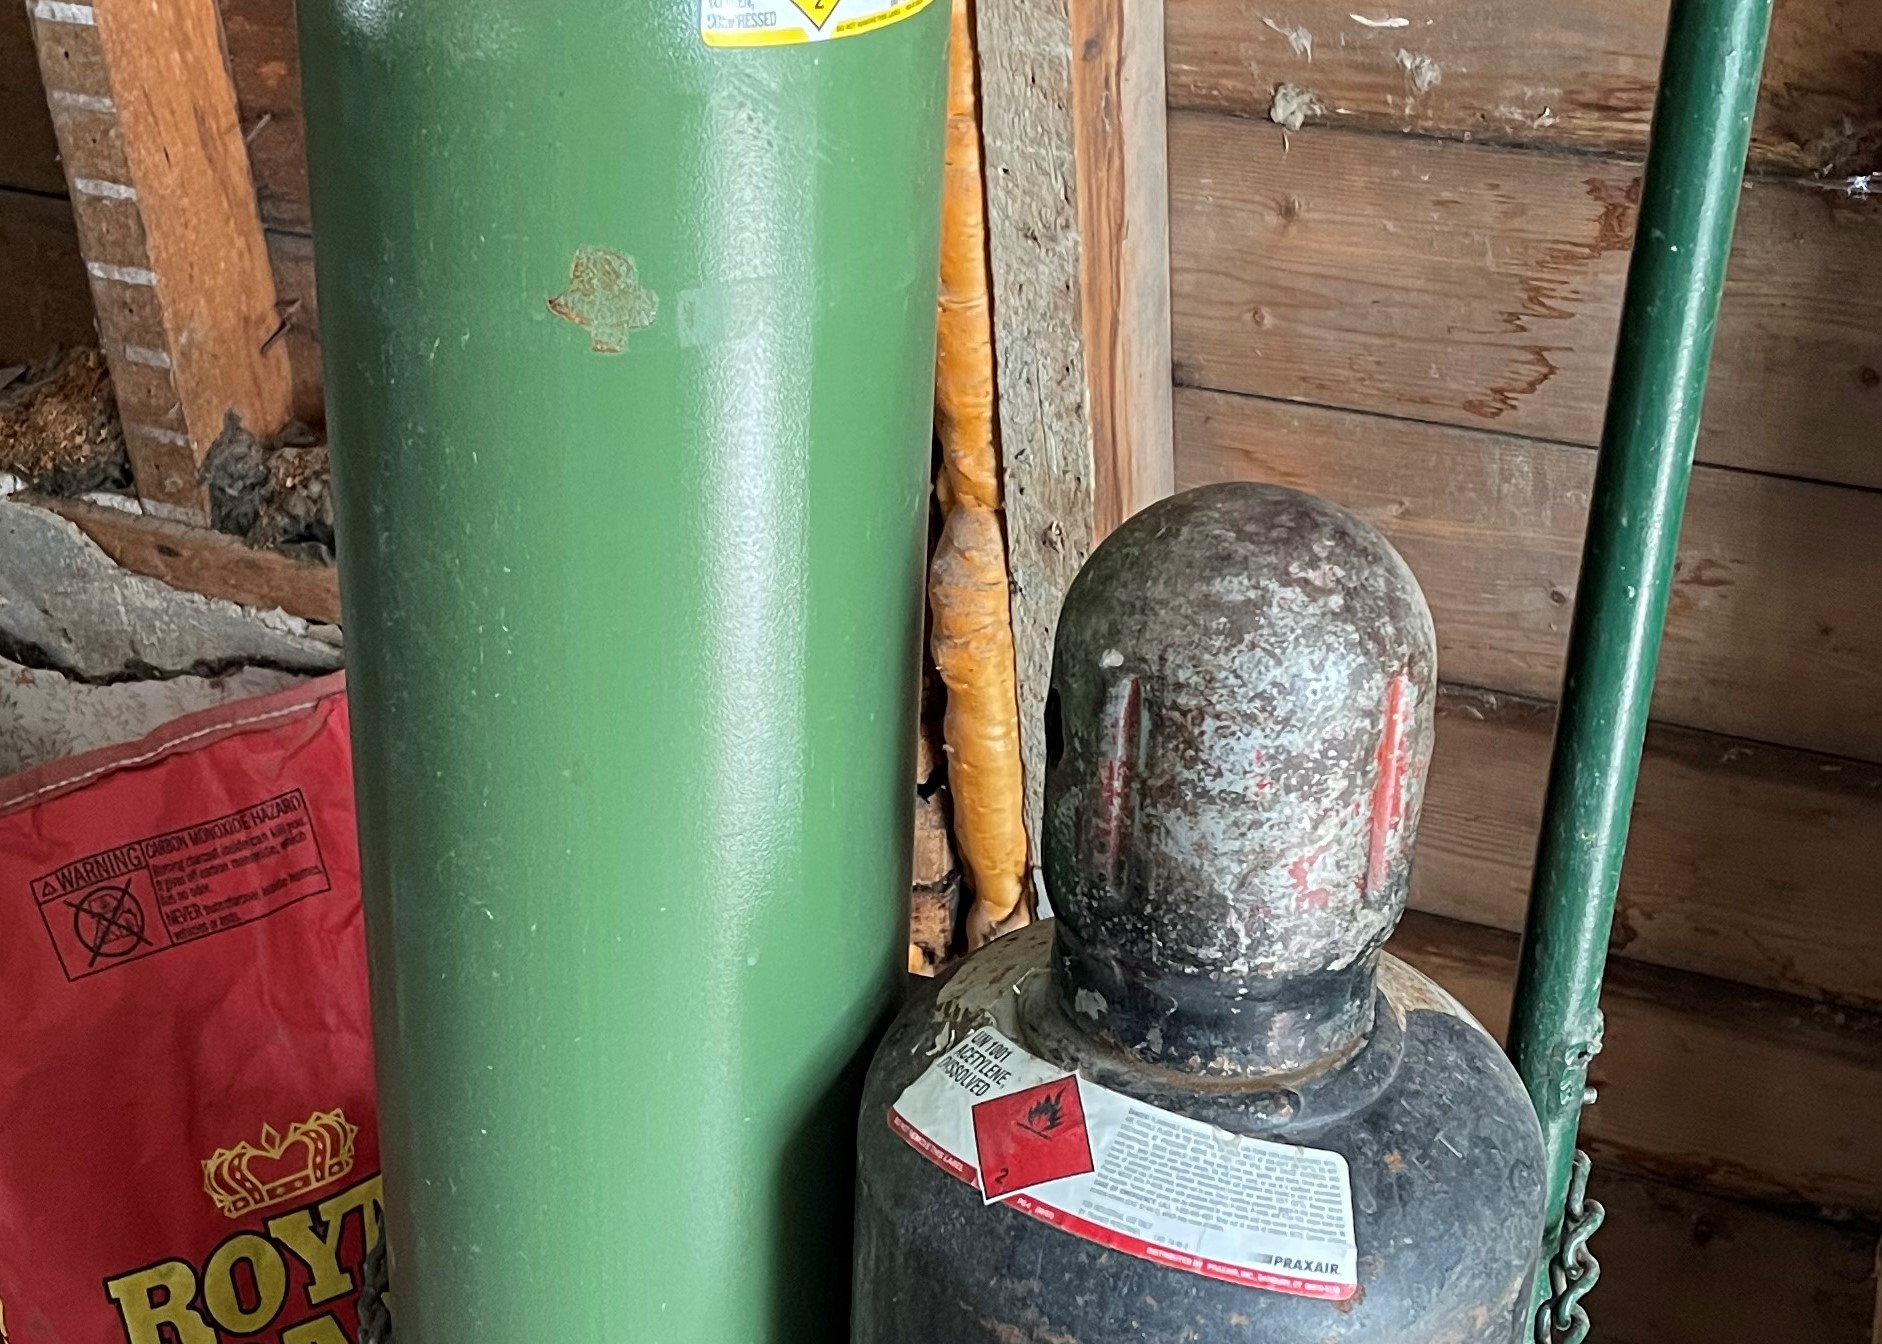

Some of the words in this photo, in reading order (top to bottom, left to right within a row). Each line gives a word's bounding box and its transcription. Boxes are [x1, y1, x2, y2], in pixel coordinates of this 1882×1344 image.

[144, 835, 188, 859] CARBON
[188, 816, 250, 850] MONOXIDE
[250, 795, 301, 827] HAZARD
[56, 848, 142, 891] WARNING
[165, 903, 202, 927] NEVER
[971, 1031, 993, 1047] UN
[988, 1039, 1014, 1060] 1001
[937, 1056, 991, 1097] DISSOLVED
[955, 1044, 1012, 1089] ACETYLENE,
[994, 1167, 1009, 1185] 2
[1273, 1255, 1339, 1275] PRAXAIR
